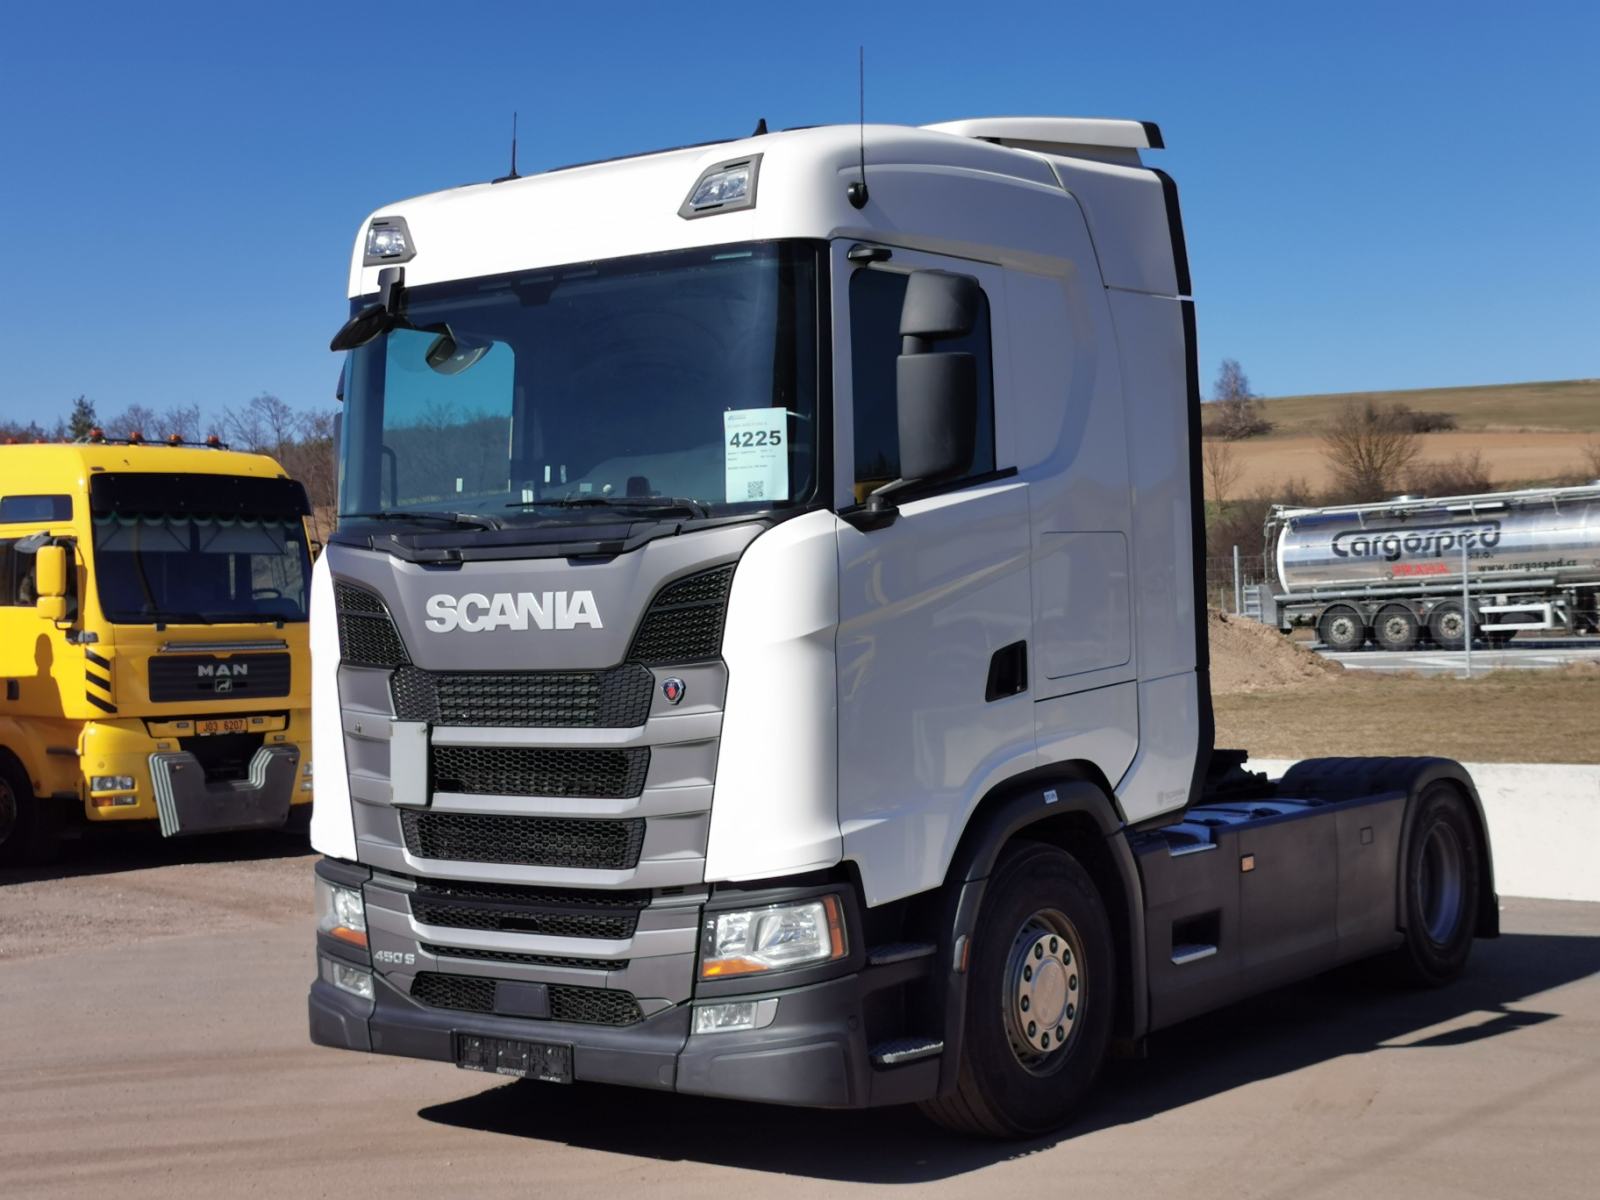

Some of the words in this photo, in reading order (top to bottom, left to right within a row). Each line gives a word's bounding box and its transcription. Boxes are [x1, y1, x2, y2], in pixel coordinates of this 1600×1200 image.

[729, 430, 782, 448] 4225
[1477, 557, 1578, 572] www.cargosped.cz
[424, 590, 604, 634] SCANIA
[197, 663, 249, 677] MAN
[374, 950, 403, 964] 450
[404, 952, 415, 965] S
